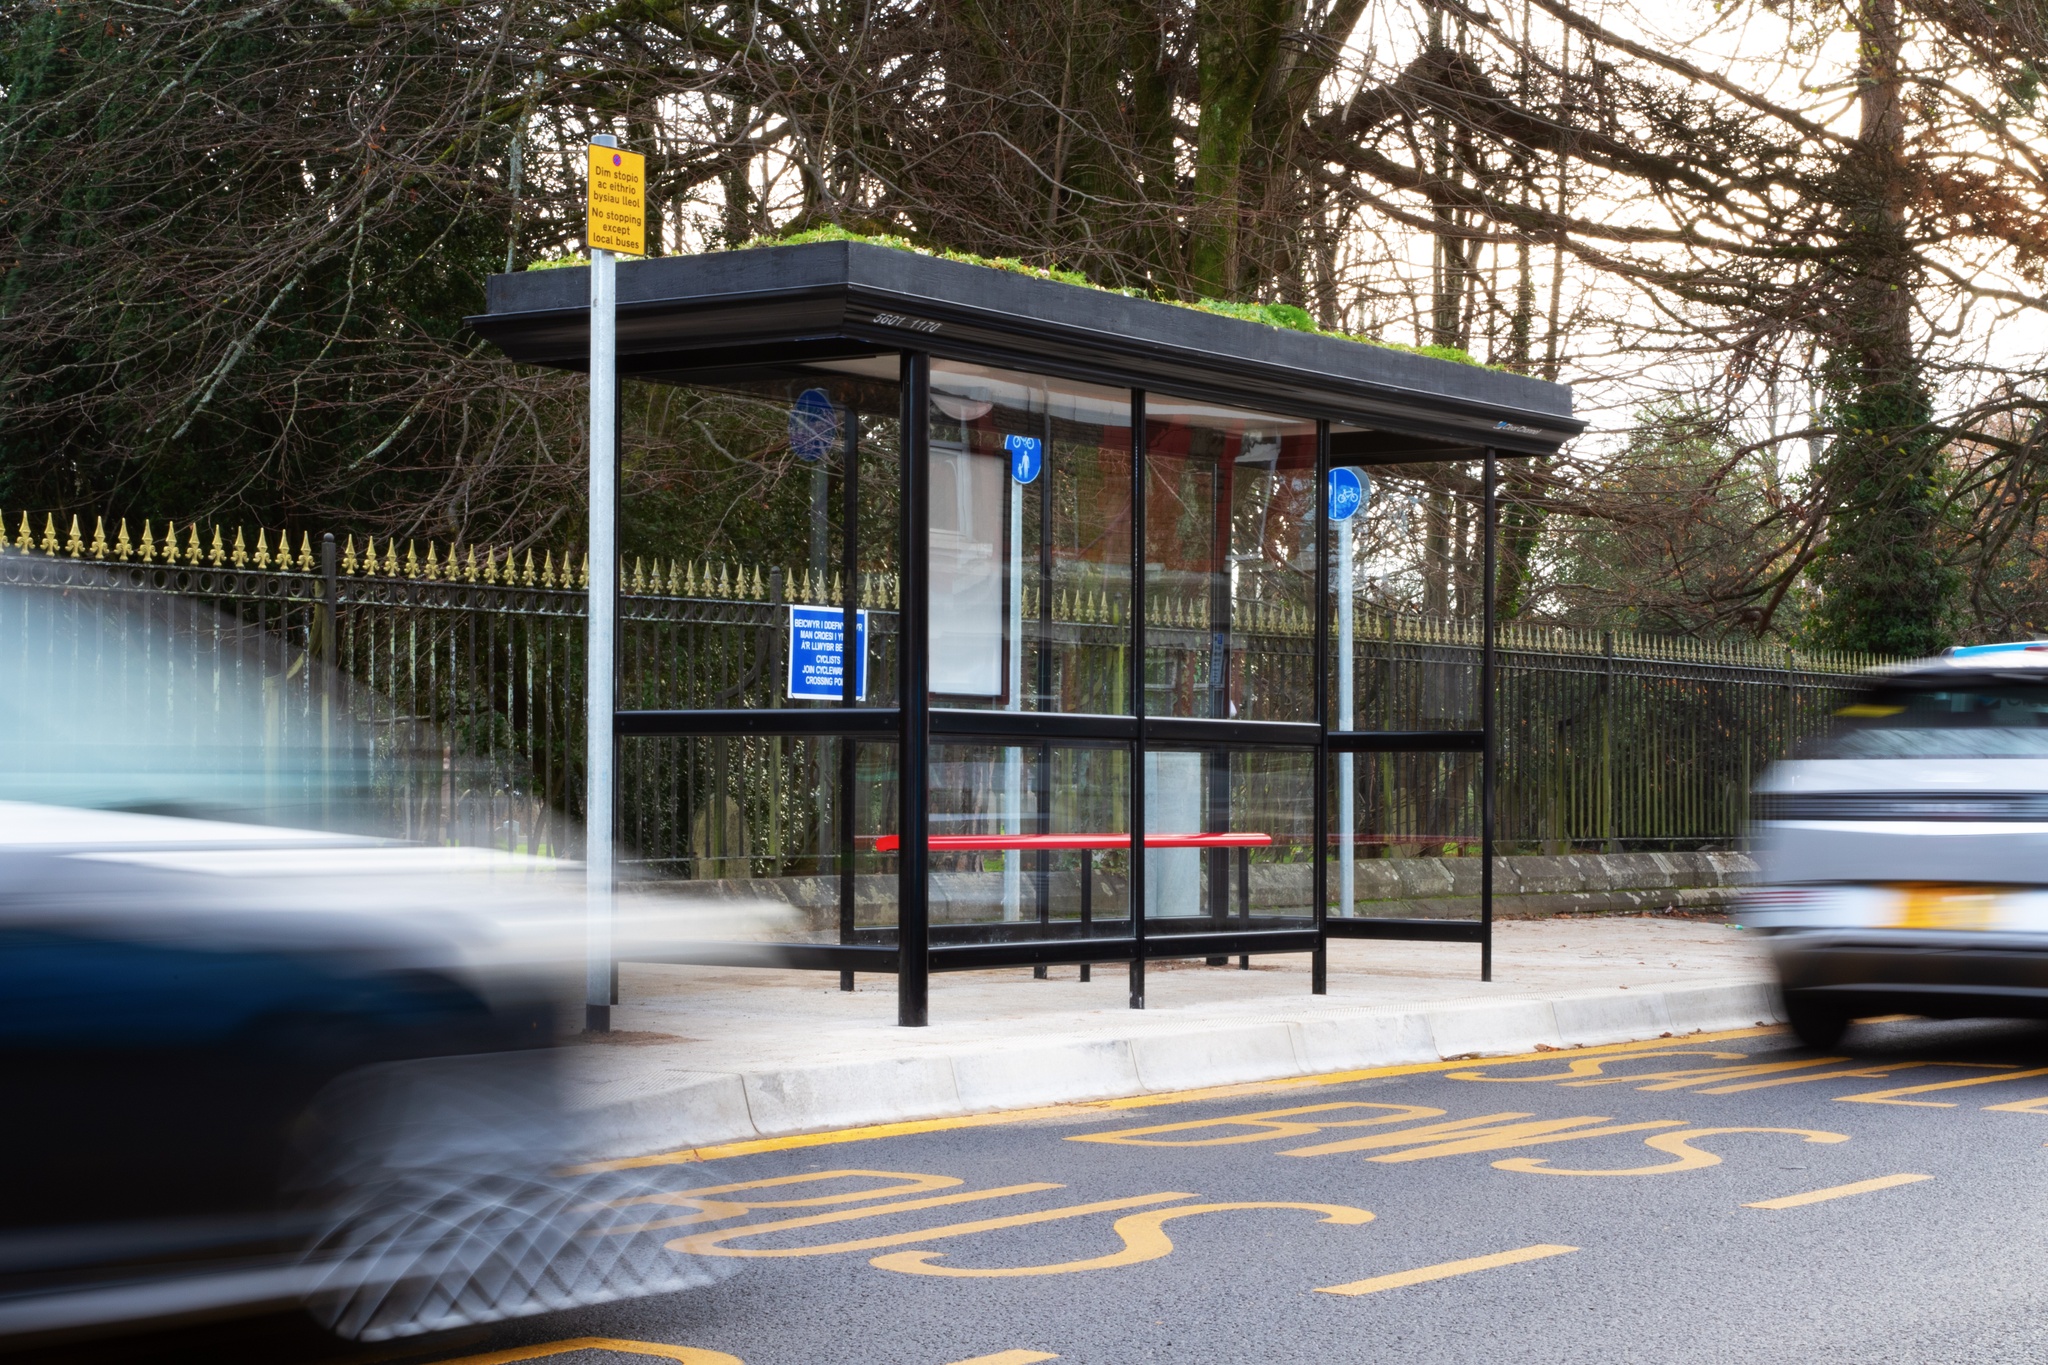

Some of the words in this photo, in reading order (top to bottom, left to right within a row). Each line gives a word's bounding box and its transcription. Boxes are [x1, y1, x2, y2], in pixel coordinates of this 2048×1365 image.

[596, 166, 611, 178] Dim
[614, 170, 638, 183] stopio
[598, 180, 606, 190] ac
[610, 182, 636, 195] eithrio
[594, 190, 620, 204] bysiau
[622, 196, 640, 208] lleol
[592, 207, 604, 218] No
[606, 211, 642, 226] stopping
[602, 223, 630, 236] except
[593, 232, 613, 244] local
[616, 238, 639, 249] buses
[872, 313, 906, 326] 5601
[910, 319, 944, 332] 1170
[1502, 423, 1518, 432] Clear
[1517, 425, 1542, 435] Channel
[794, 618, 820, 628] BEICWYR
[800, 630, 813, 639] MAN
[814, 630, 834, 640] CROESI
[812, 642, 834, 651] LLWYBR
[835, 643, 844, 652] BE
[816, 654, 841, 664] CYCLISTS
[802, 665, 814, 674] JOIN
[806, 676, 833, 686] CROSSING
[834, 678, 844, 686] POI
[1064, 1101, 1852, 1178] BWS
[570, 1168, 1376, 1278] BUS
